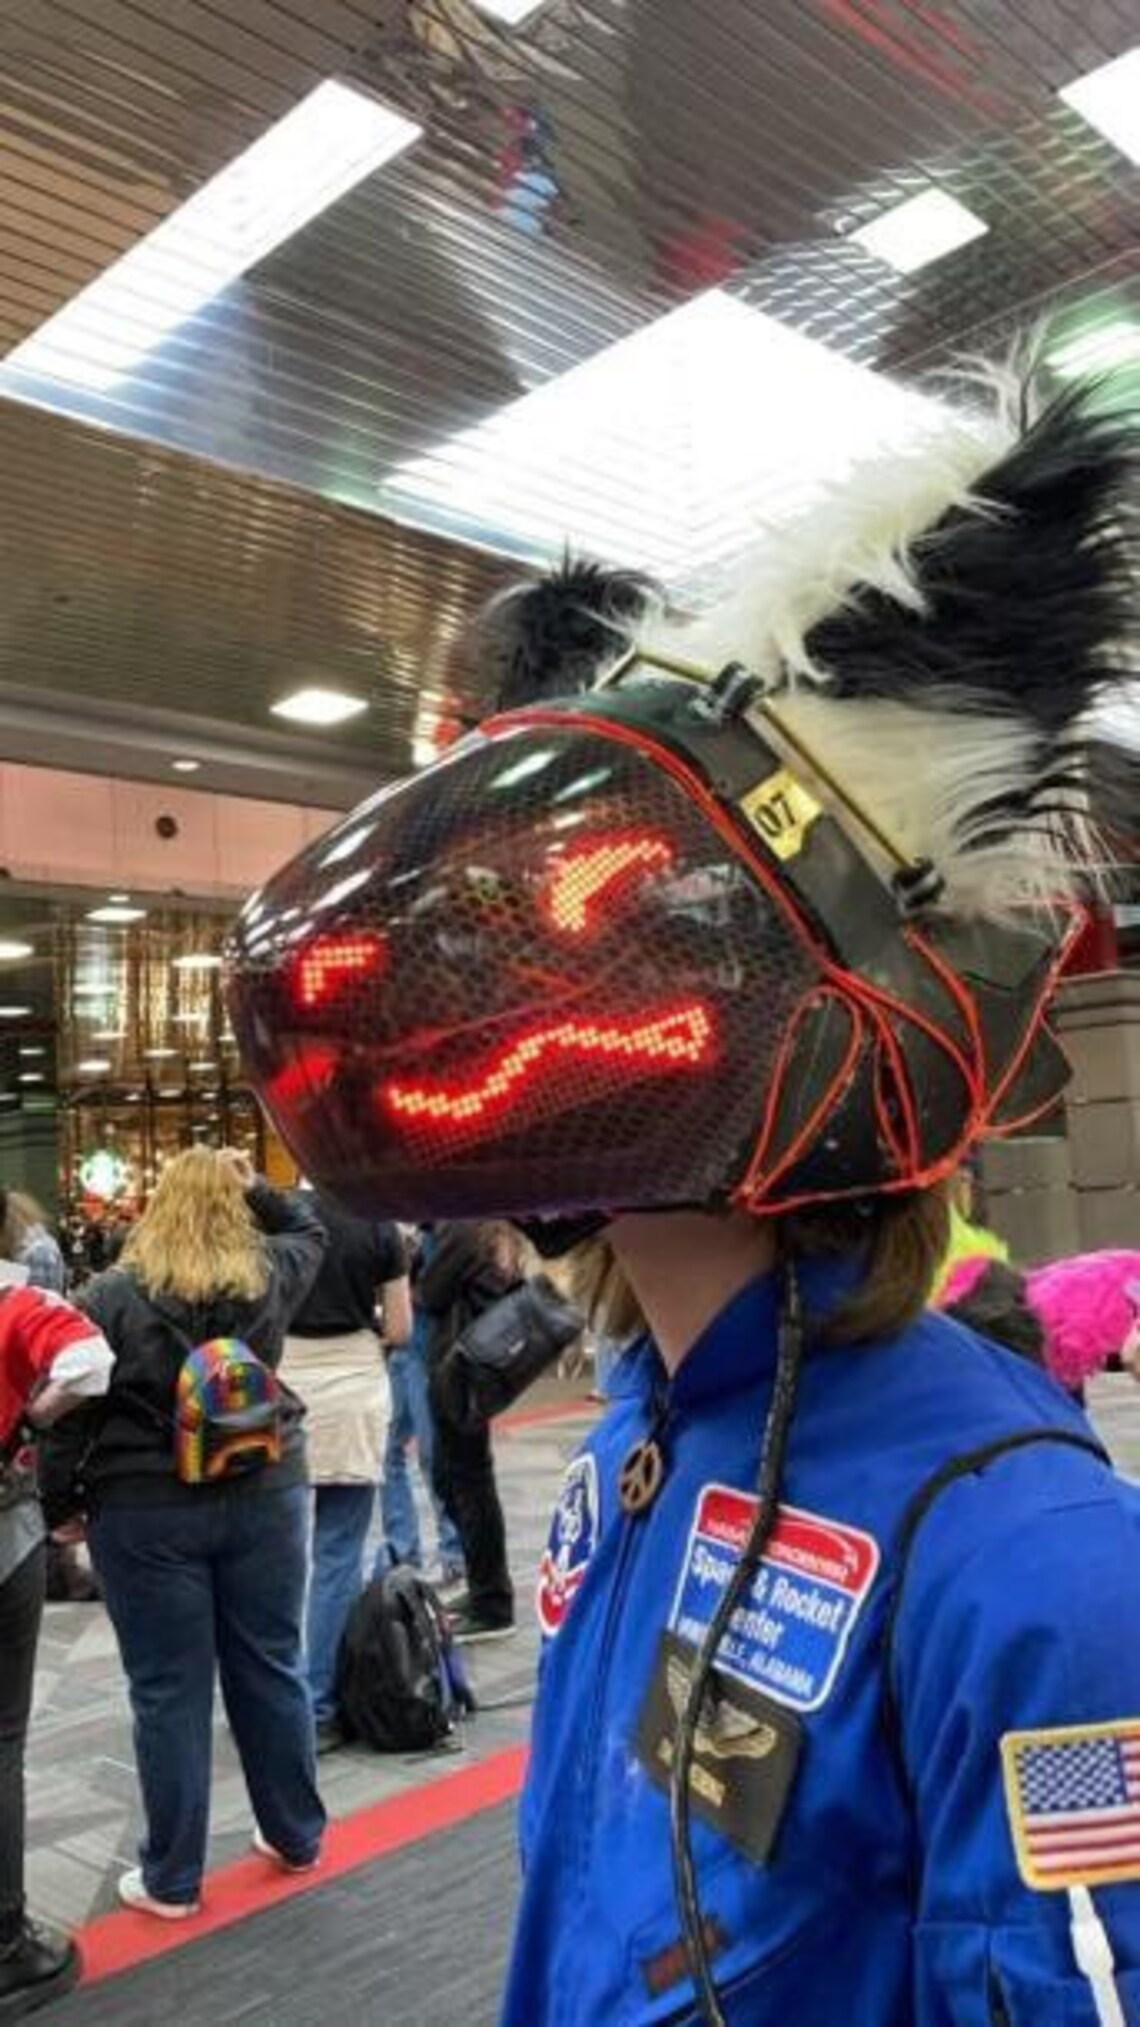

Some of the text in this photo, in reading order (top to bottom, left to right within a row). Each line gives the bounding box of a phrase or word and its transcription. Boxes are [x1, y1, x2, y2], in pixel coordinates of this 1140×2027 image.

[754, 790, 796, 837] 07
[691, 1545, 738, 1589] Spac
[752, 1568, 769, 1603] &
[770, 1576, 845, 1634] Rocket
[729, 1607, 785, 1650] enter
